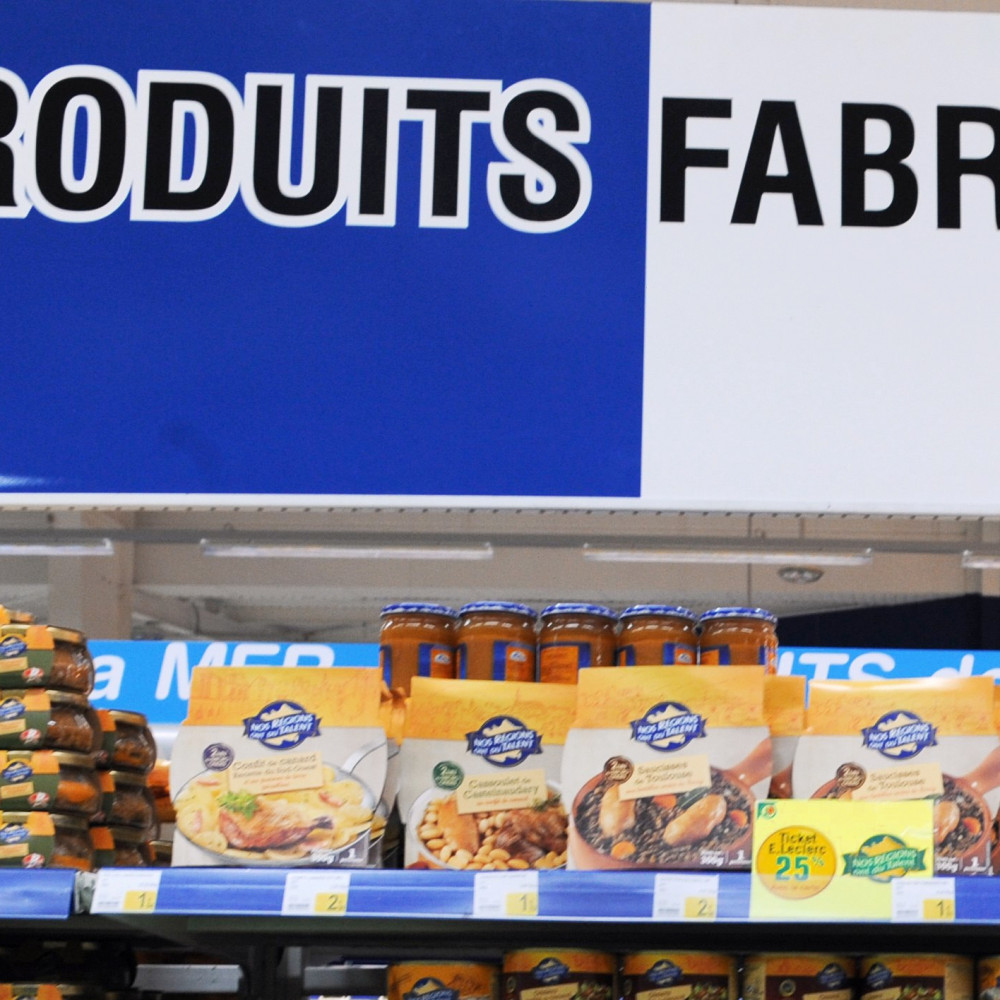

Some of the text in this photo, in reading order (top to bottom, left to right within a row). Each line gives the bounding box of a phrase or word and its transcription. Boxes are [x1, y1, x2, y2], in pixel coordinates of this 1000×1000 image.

[0, 66, 591, 233] ODUITS
[88, 654, 126, 700] a
[779, 831, 817, 845] Ticket
